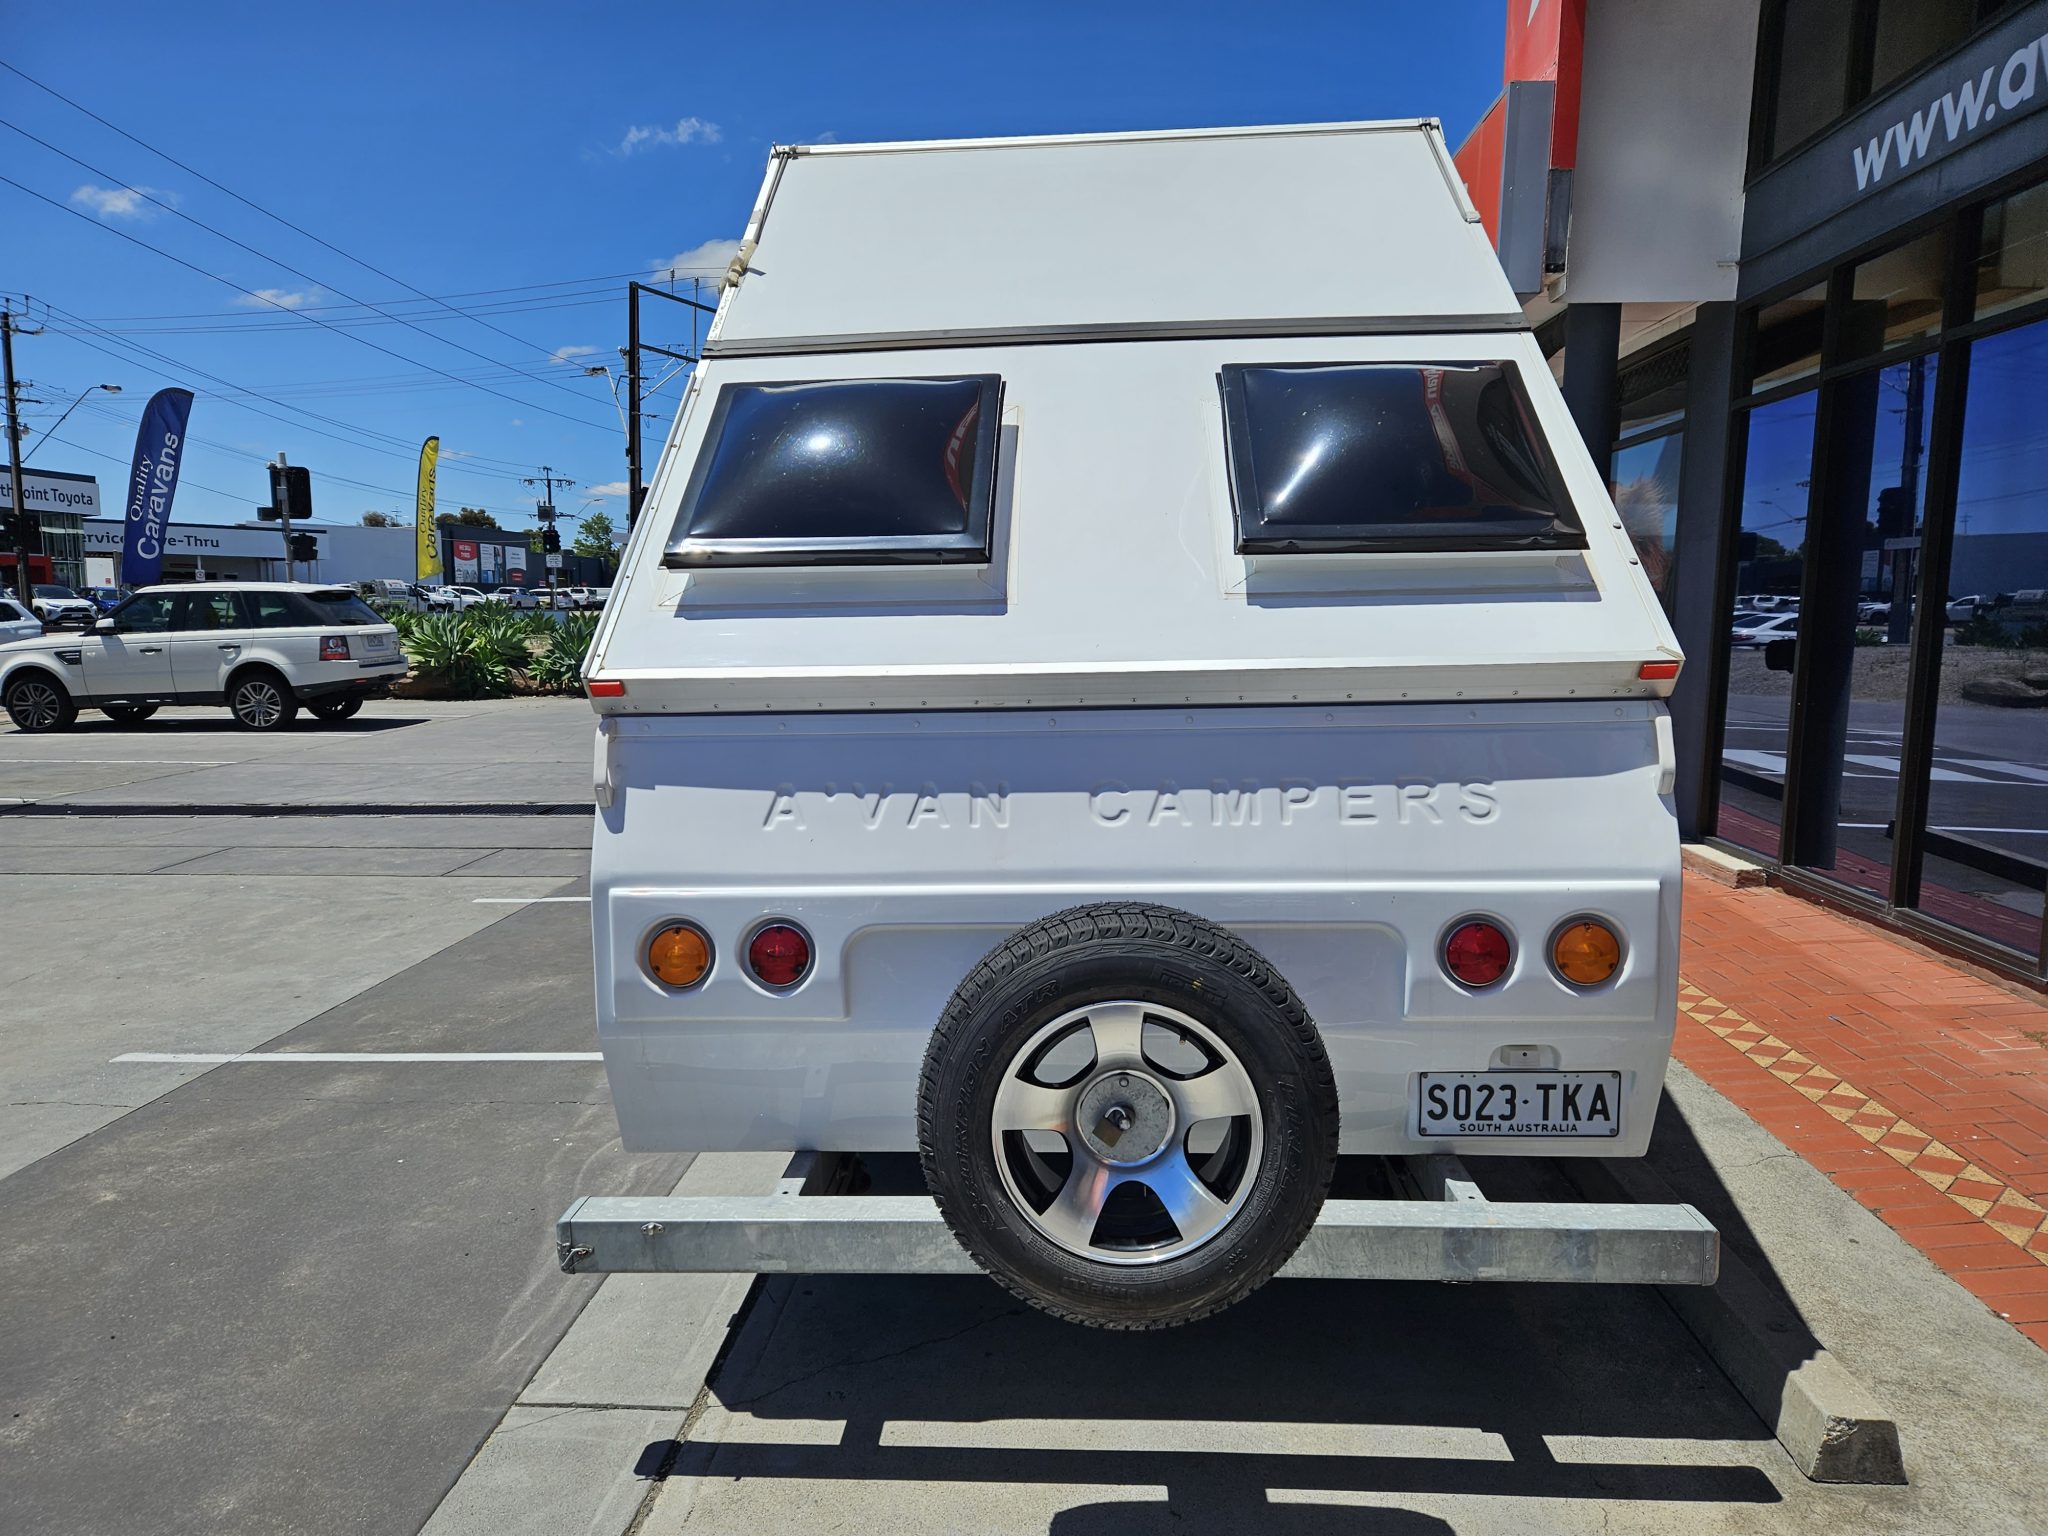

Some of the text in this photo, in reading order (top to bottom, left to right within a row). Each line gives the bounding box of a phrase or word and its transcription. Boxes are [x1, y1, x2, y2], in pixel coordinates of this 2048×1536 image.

[50, 488, 93, 507] Toyota
[131, 454, 153, 521] Quality
[137, 432, 180, 559] Caravans
[762, 776, 1501, 831] A'VAN CAMPERS
[1459, 1123, 1578, 1133] SOUTH AUSTRALIA
